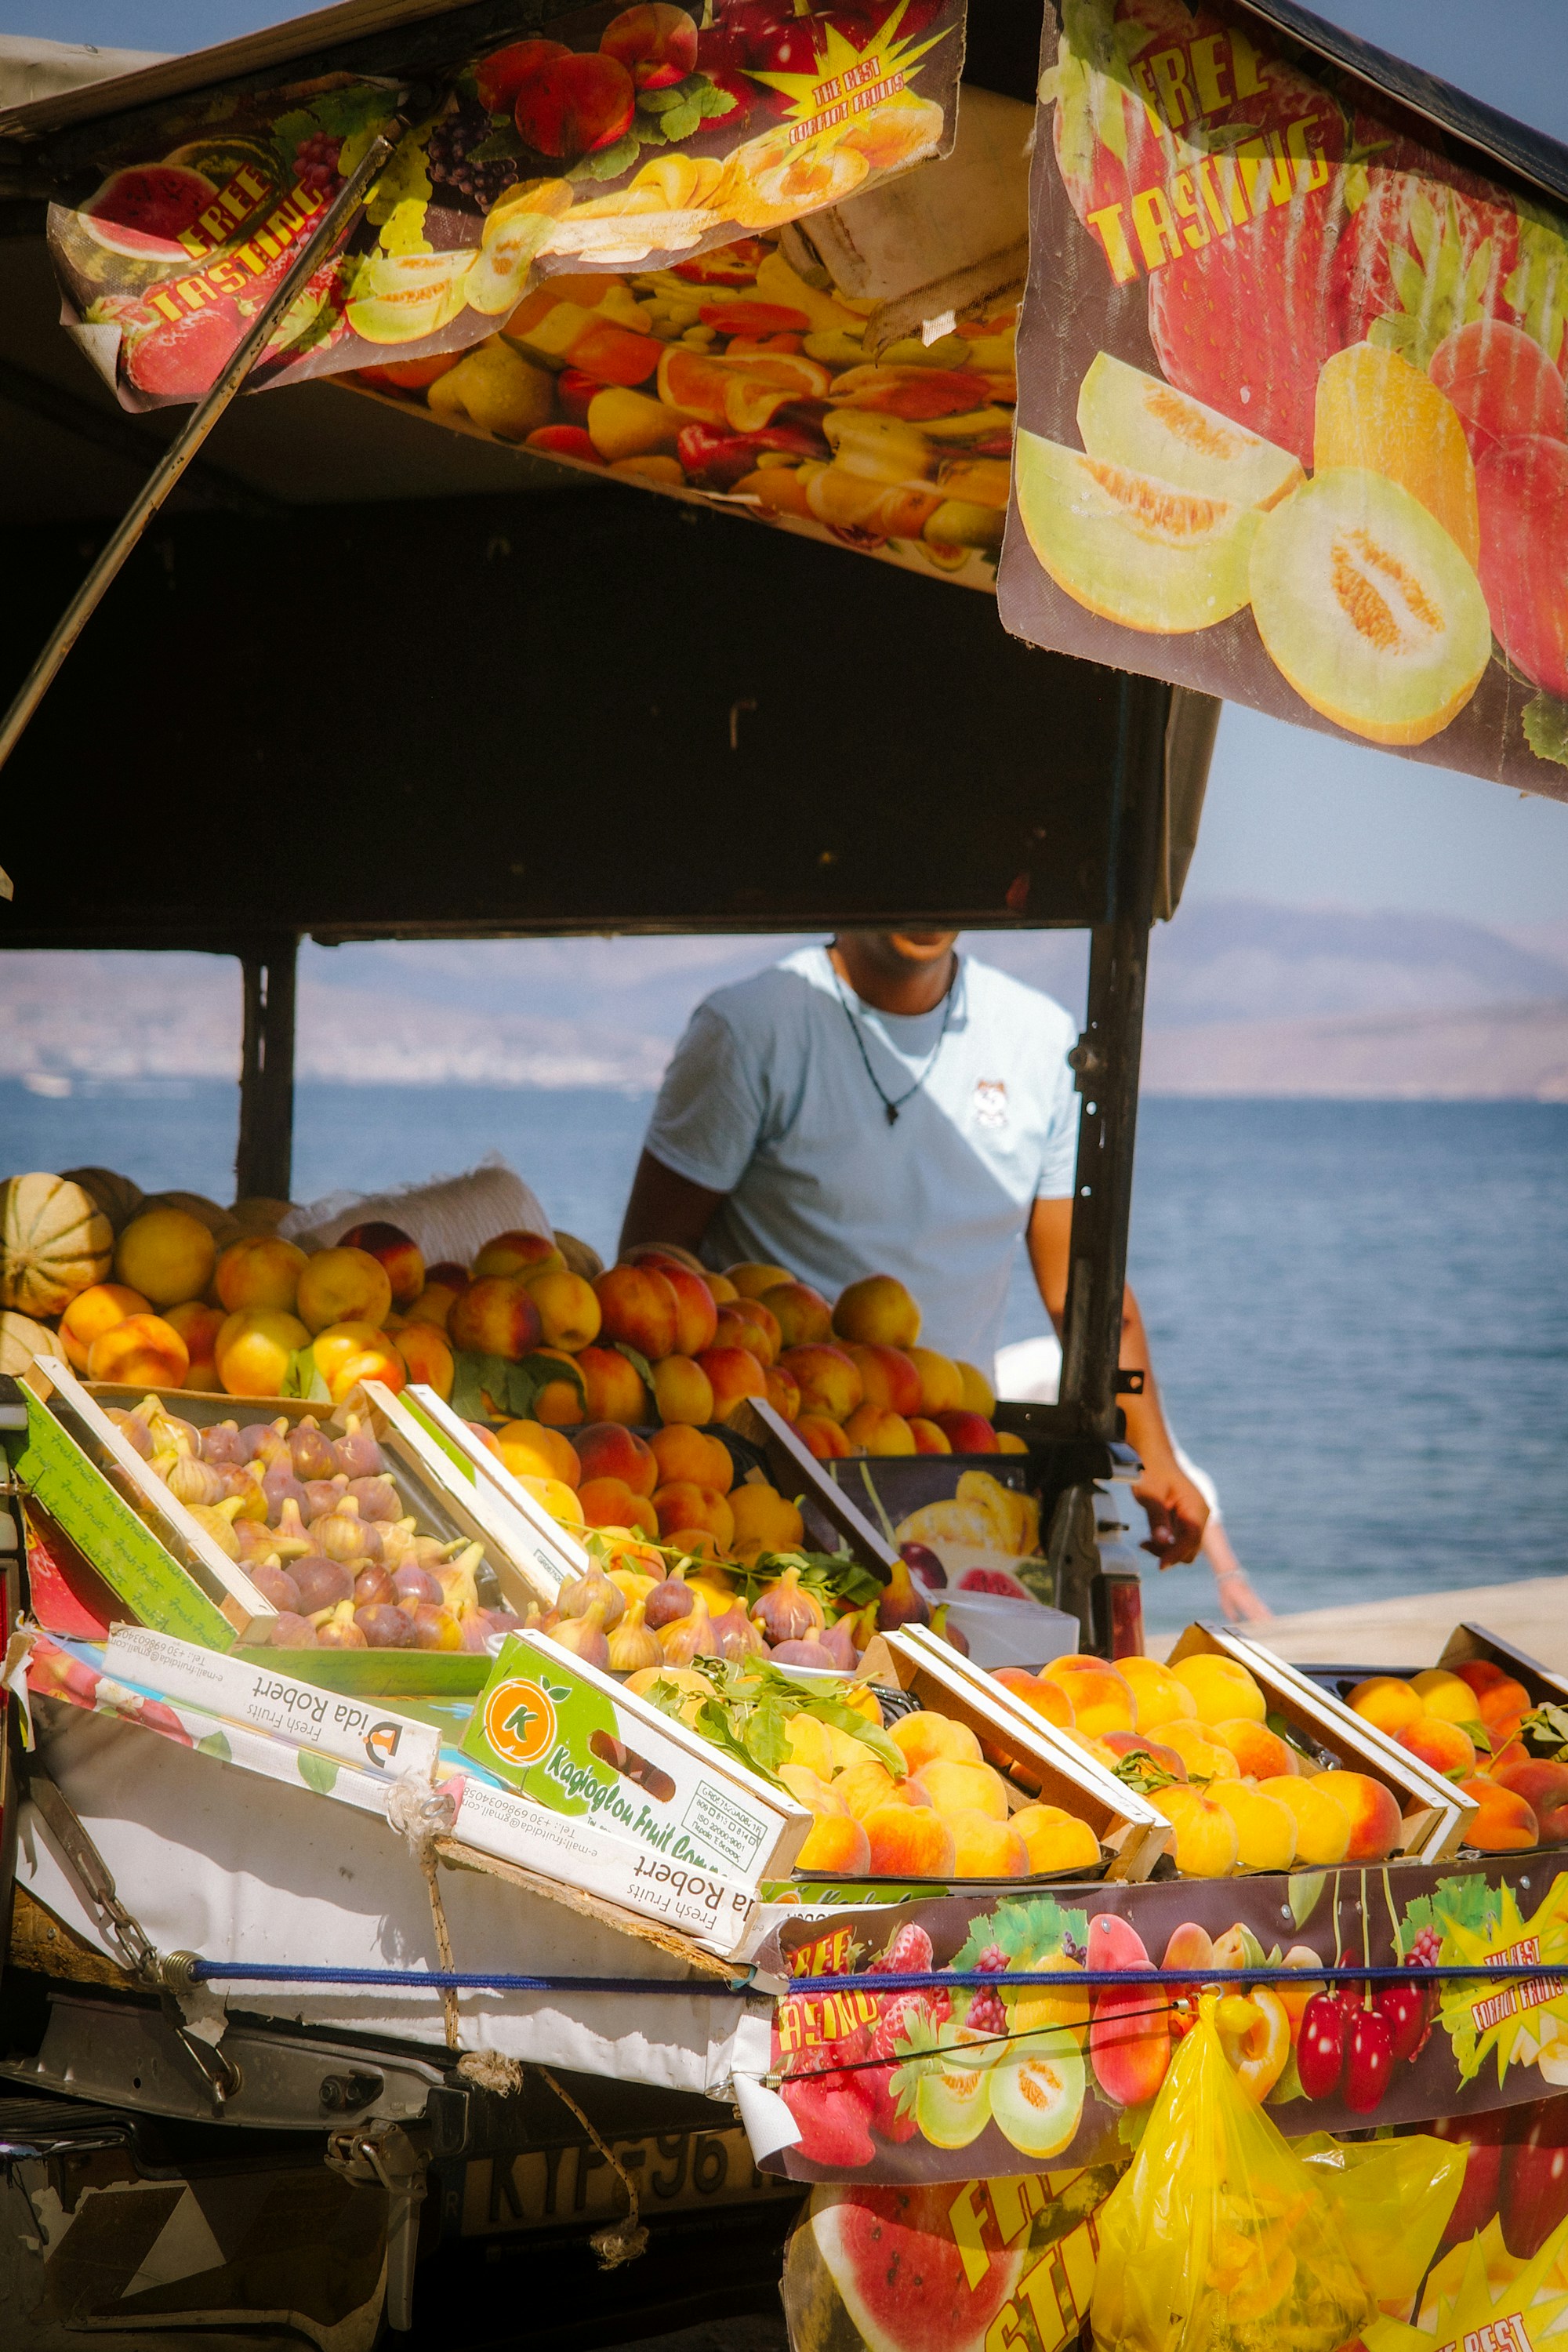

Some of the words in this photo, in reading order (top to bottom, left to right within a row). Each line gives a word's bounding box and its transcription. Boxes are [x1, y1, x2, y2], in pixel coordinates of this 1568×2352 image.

[812, 81, 841, 107] THE
[844, 56, 881, 91] BEST
[1129, 29, 1269, 140] FREE
[789, 101, 848, 146] CORFIOT
[853, 71, 904, 114] FRUITS
[176, 164, 271, 260] FREE
[147, 177, 325, 323] TASTING
[167, 1646, 185, 1657] +30
[246, 1704, 284, 1730] Fruits
[252, 1676, 328, 1723] Robert
[286, 1718, 322, 1742] Fresh
[334, 1704, 403, 1768] Dida
[503, 1705, 539, 1742] K
[463, 1787, 528, 1819] 6986034058
[529, 1813, 551, 1827] +30
[546, 1744, 634, 1828] Kagioglou
[632, 1805, 676, 1853] Fruit
[671, 1835, 729, 1877] Com
[696, 1798, 709, 1812] 809
[736, 1827, 749, 1841] 814
[697, 1813, 710, 1826] ISO
[626, 1883, 671, 1913] Fruits
[633, 1855, 725, 1911] Robert
[675, 1904, 717, 1931] Fresh
[786, 1929, 849, 1977] REE
[1471, 1984, 1519, 2033] CORFIOT
[1517, 1975, 1564, 2011] FRUITS
